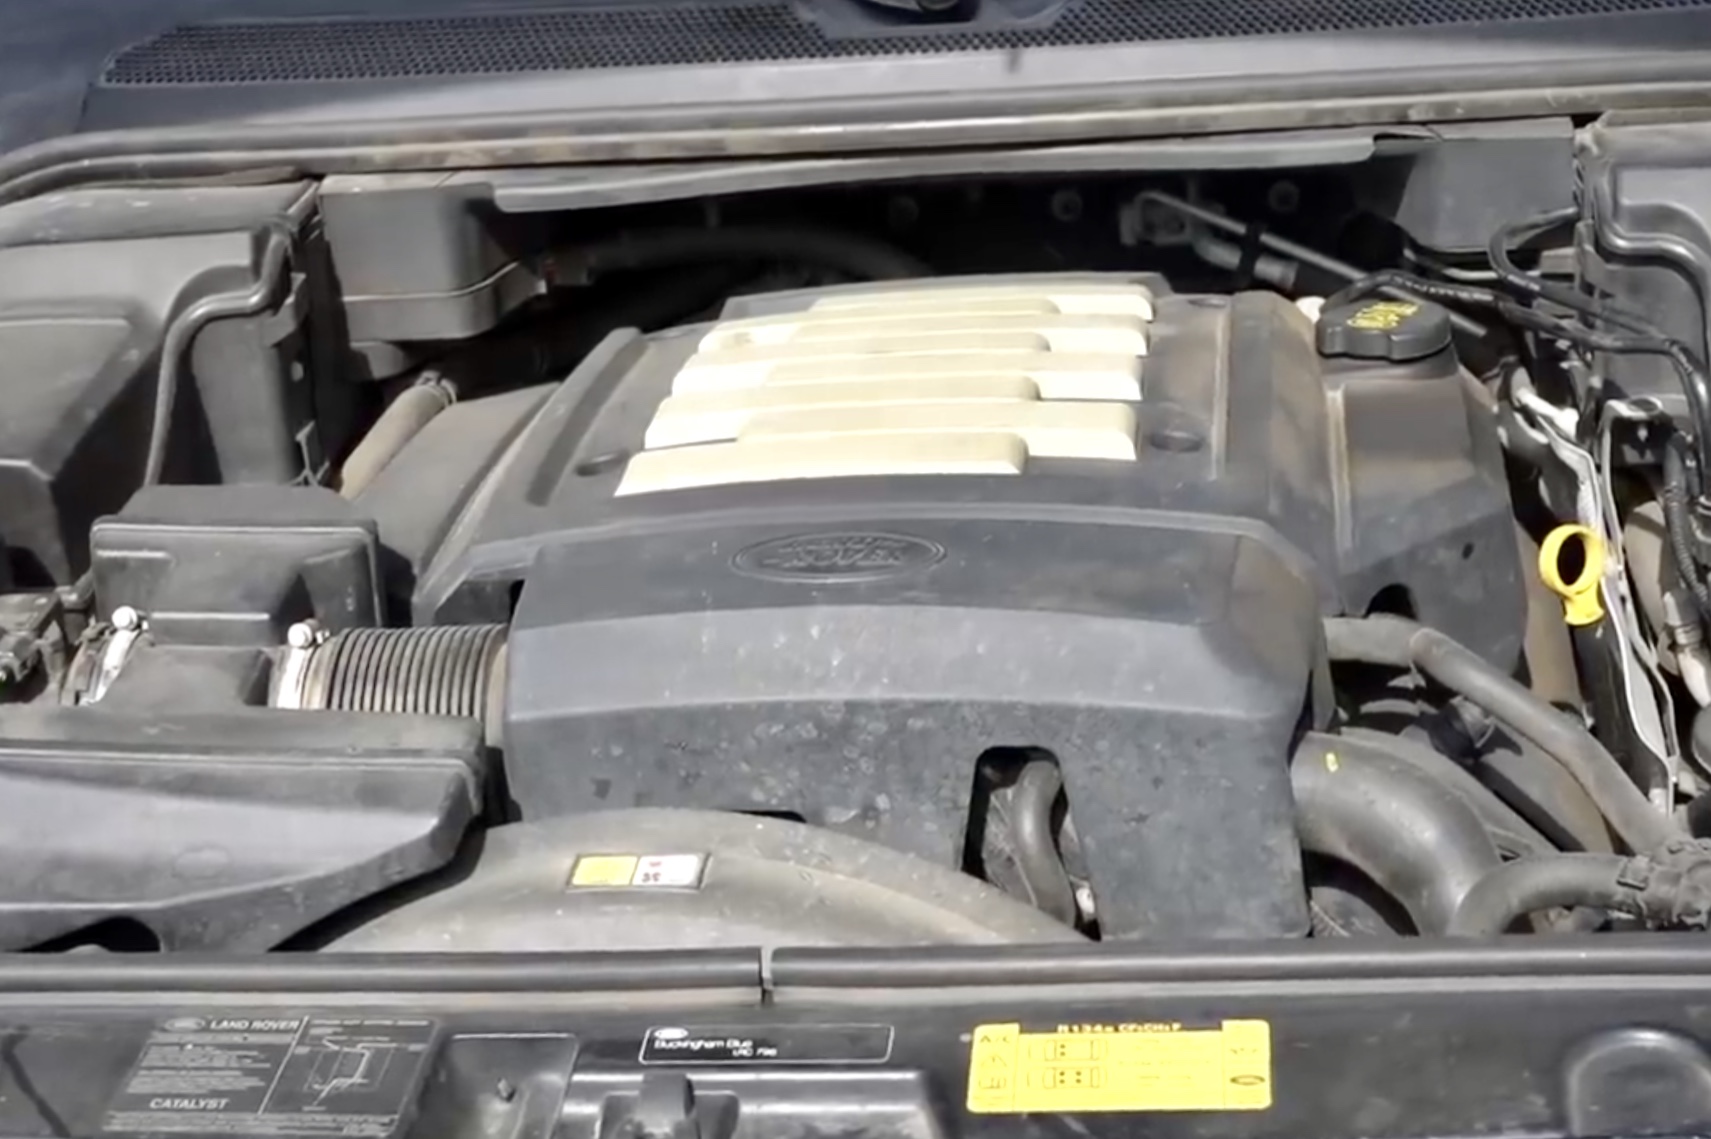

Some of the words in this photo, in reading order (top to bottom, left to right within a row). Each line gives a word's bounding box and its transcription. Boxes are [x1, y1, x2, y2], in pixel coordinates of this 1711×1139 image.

[210, 1019, 249, 1031] LAND
[250, 1019, 300, 1031] ROVER
[654, 1038, 724, 1051] Buckingham
[726, 1038, 753, 1049] Blue
[149, 1097, 230, 1110] CATALYST
